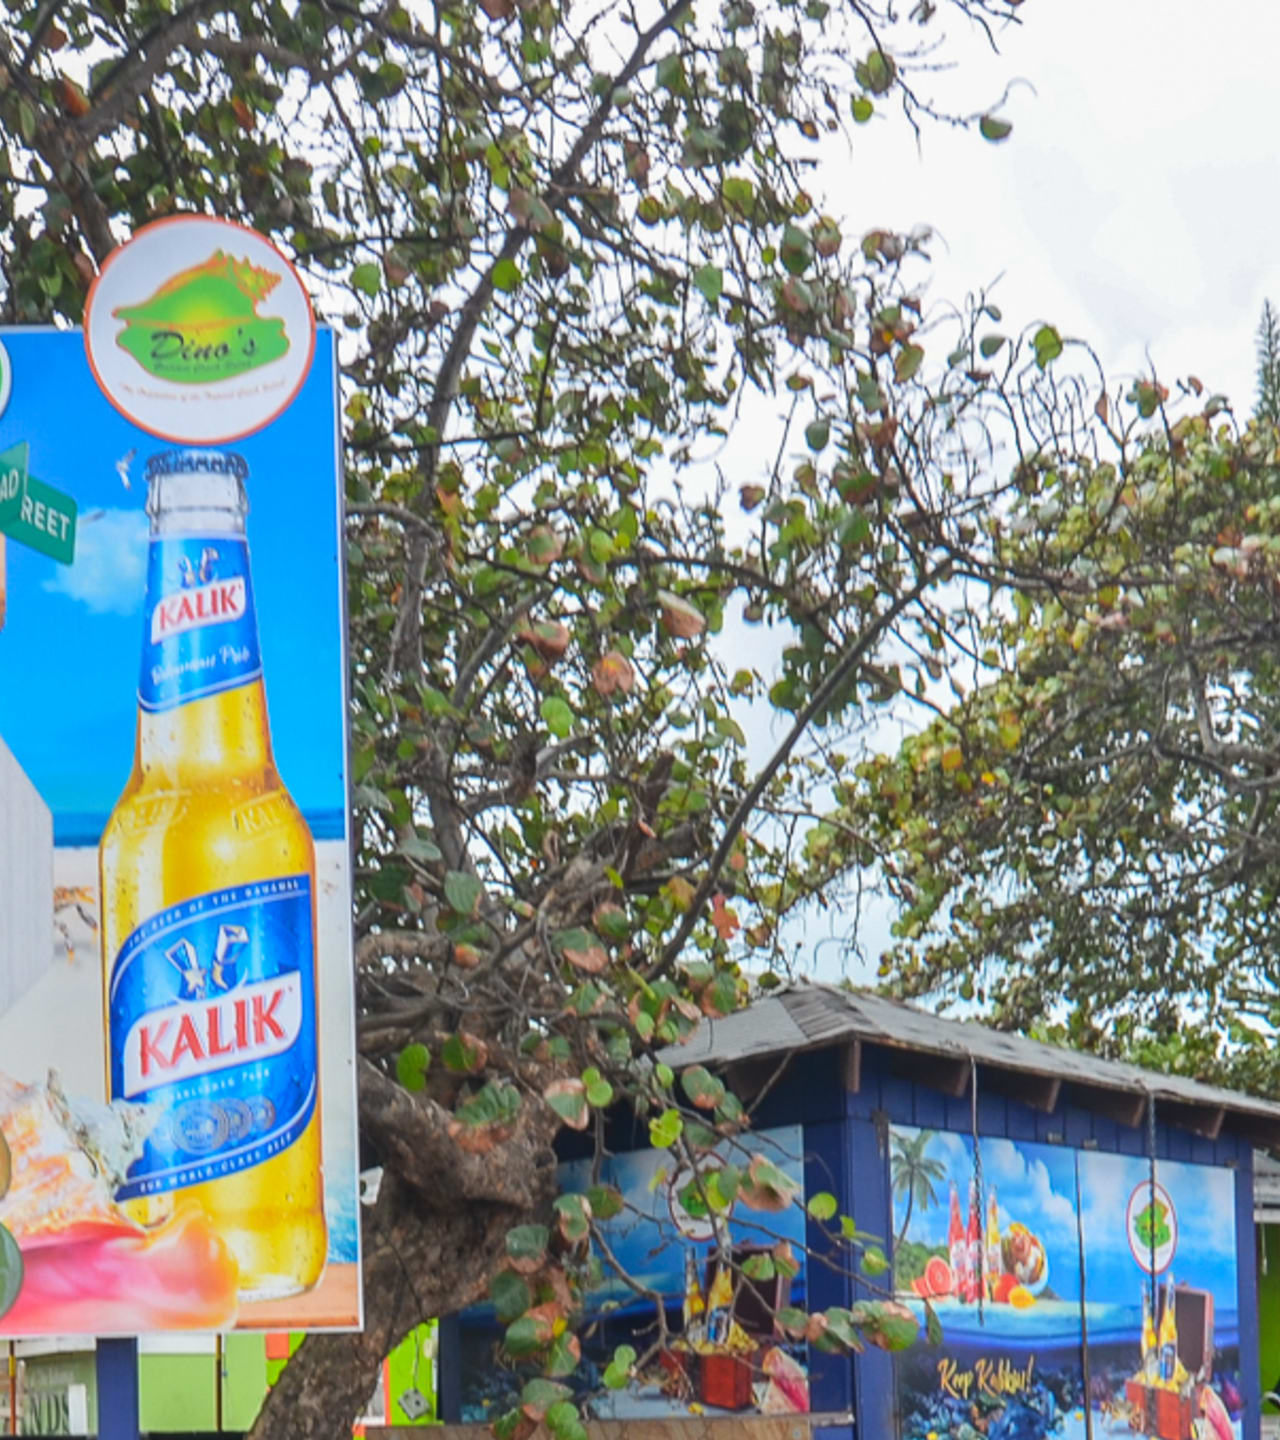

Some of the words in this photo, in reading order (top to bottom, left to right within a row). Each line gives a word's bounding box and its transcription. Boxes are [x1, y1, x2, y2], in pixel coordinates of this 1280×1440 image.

[151, 327, 258, 361] Dino's
[20, 495, 70, 541] REET
[160, 584, 238, 630] KALIK
[138, 988, 285, 1078] KALIK
